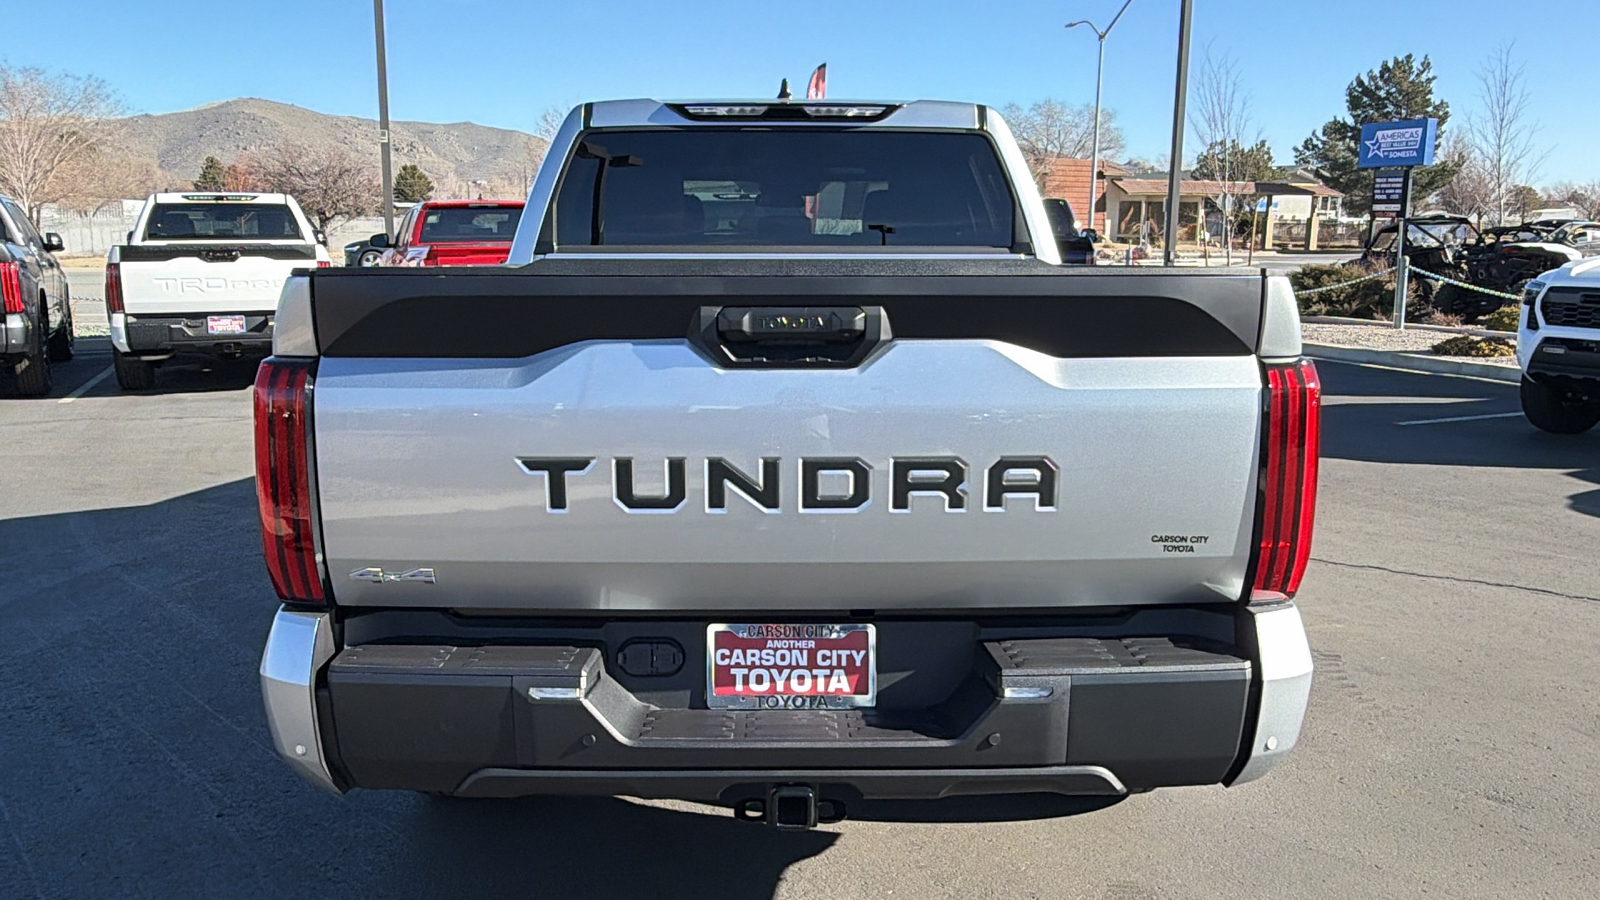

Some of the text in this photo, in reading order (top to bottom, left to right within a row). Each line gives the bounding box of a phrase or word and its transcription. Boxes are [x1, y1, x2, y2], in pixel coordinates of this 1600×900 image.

[1380, 129, 1419, 140] AMERICAS
[1389, 150, 1417, 158] SONESTA
[760, 316, 824, 330] TOYOTA
[513, 455, 1063, 515] TUNDRA
[1150, 534, 1209, 543] CARSON CITY
[1162, 544, 1194, 552] TOYOTA
[747, 625, 834, 637] CARSON CITY
[766, 640, 815, 648] ANOTHER
[715, 648, 868, 667] CARSON CITY
[730, 668, 852, 693] TOYOTA
[755, 695, 830, 709] TOYOTA
